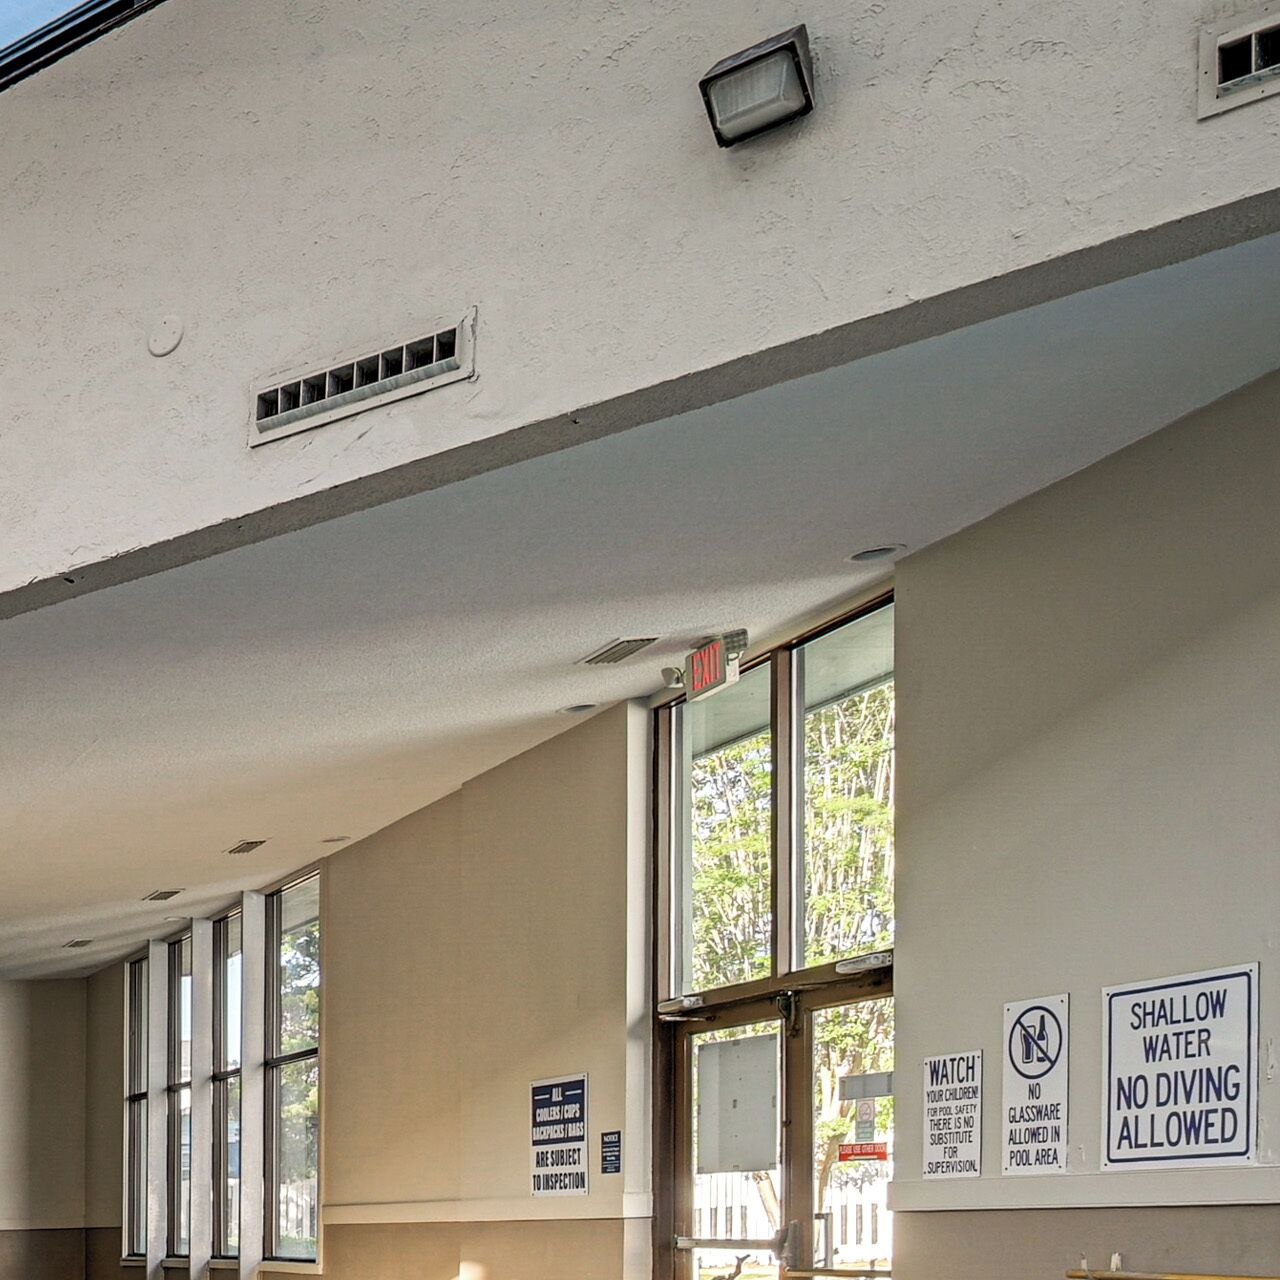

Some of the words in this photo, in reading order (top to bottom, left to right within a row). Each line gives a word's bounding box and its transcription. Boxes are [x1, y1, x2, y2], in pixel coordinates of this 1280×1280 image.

[692, 641, 721, 692] EXIT
[1130, 988, 1227, 1030] SHALLOW
[1143, 1028, 1211, 1063] WATER
[929, 1055, 975, 1086] WATCH
[552, 1087, 562, 1102] ALL
[926, 1090, 944, 1103] YOUR
[945, 1086, 978, 1102] CHILDREN!
[1028, 1082, 1041, 1100] NO
[1116, 1074, 1148, 1110] NO
[1156, 1064, 1240, 1107] DIVING
[536, 1105, 560, 1122] COOLERS
[564, 1103, 580, 1119] CUPS
[927, 1107, 938, 1118] FOR
[939, 1106, 953, 1116] POOL
[954, 1104, 977, 1115] SAFETY
[1008, 1103, 1061, 1123] GLASSWARE
[533, 1124, 564, 1140] BACKPACKS
[568, 1122, 584, 1136] BAGS
[930, 1118, 952, 1132] THERE
[954, 1117, 962, 1130] IS
[964, 1116, 974, 1129] NO
[1116, 1107, 1238, 1150] ALLOWED
[930, 1130, 973, 1146] SUBSTITUTE
[1008, 1126, 1048, 1145] ALLOWED
[1051, 1125, 1060, 1142] IN
[536, 1150, 549, 1168] ARE
[550, 1148, 581, 1166] SUBJECT
[944, 1146, 958, 1159] FOR
[1010, 1150, 1032, 1166] POOL
[1034, 1148, 1058, 1166] AREA
[532, 1174, 541, 1191] TO
[542, 1172, 585, 1190] INSPECTION
